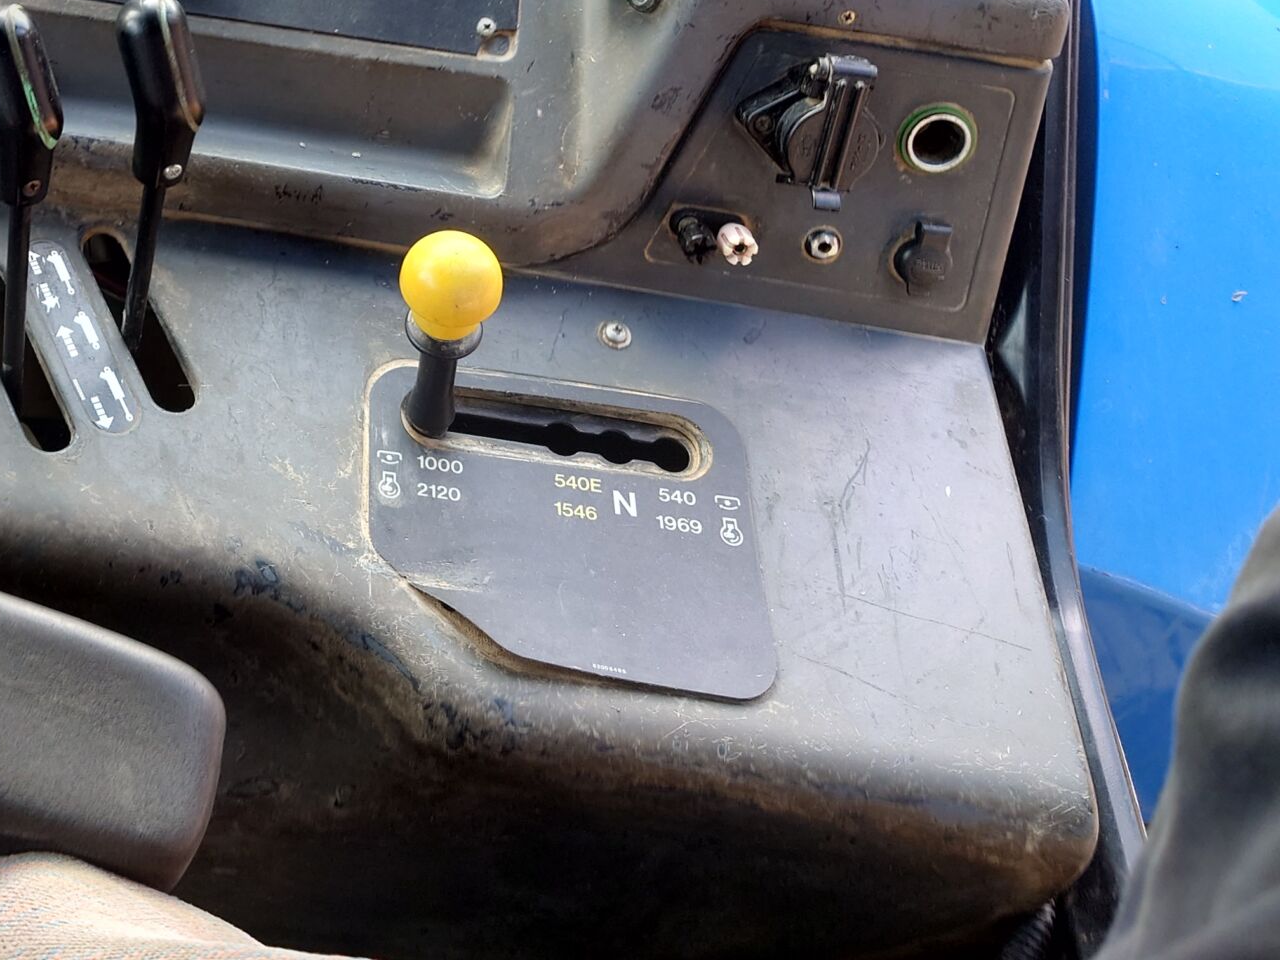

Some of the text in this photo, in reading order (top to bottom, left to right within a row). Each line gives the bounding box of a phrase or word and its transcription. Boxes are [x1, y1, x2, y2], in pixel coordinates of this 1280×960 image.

[416, 456, 464, 474] 1000
[416, 482, 461, 502] 2120
[554, 473, 602, 493] 540E
[612, 490, 638, 518] N
[658, 488, 696, 506] 540
[554, 502, 598, 520] 1546
[656, 515, 702, 534] 1969
